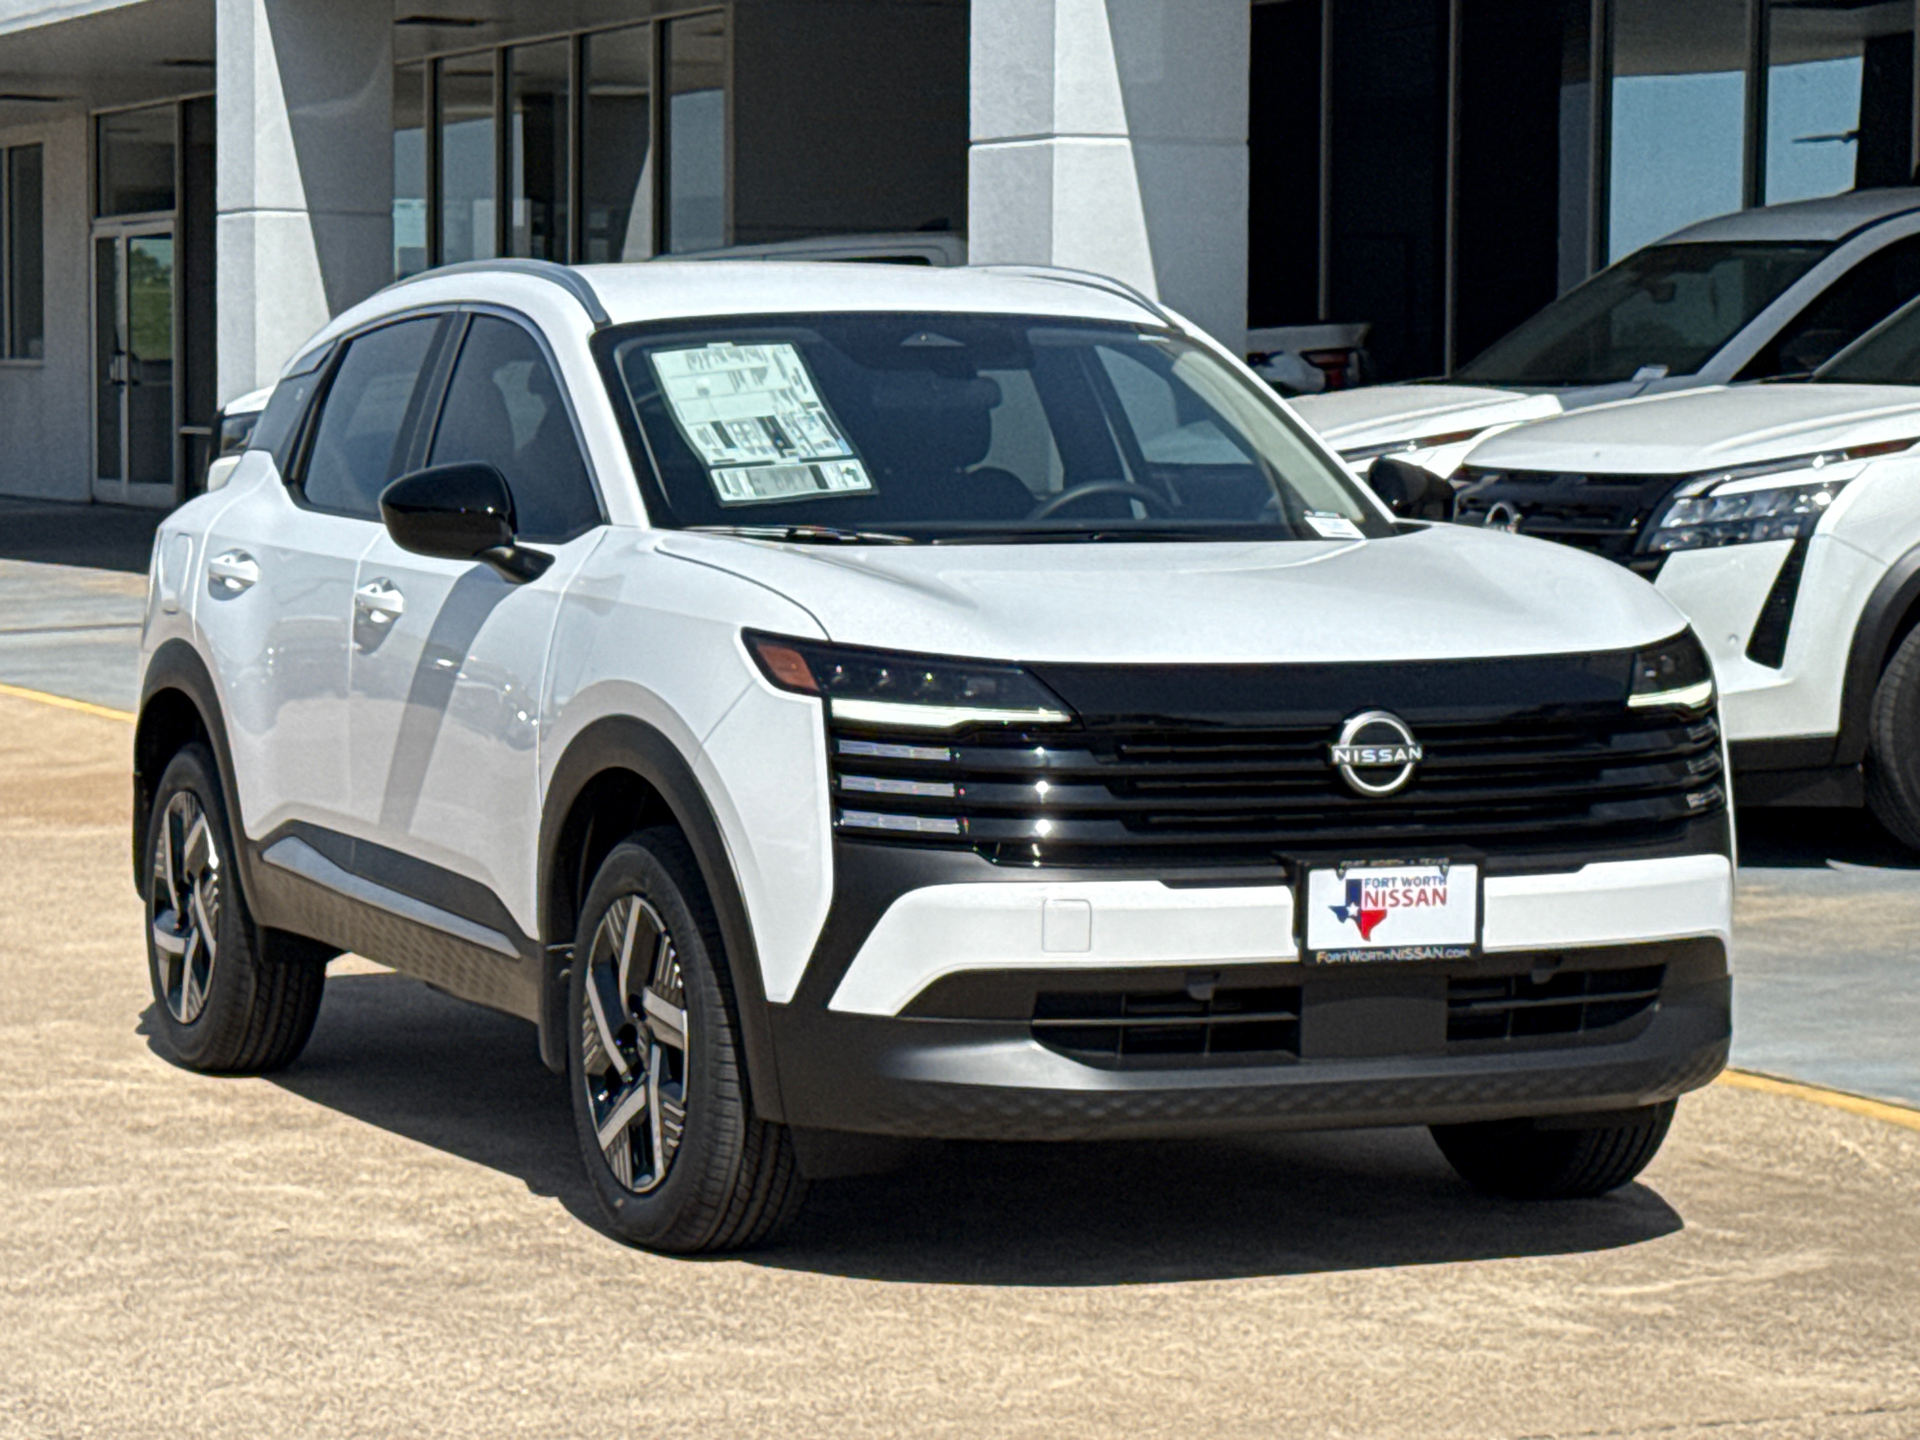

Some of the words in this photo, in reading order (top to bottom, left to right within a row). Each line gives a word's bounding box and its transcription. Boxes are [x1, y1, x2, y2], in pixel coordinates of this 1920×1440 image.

[1333, 746, 1422, 763] NISSAN
[1364, 876, 1398, 888] FORT
[1401, 875, 1447, 887] WORTH
[1364, 887, 1448, 908] NISSAN
